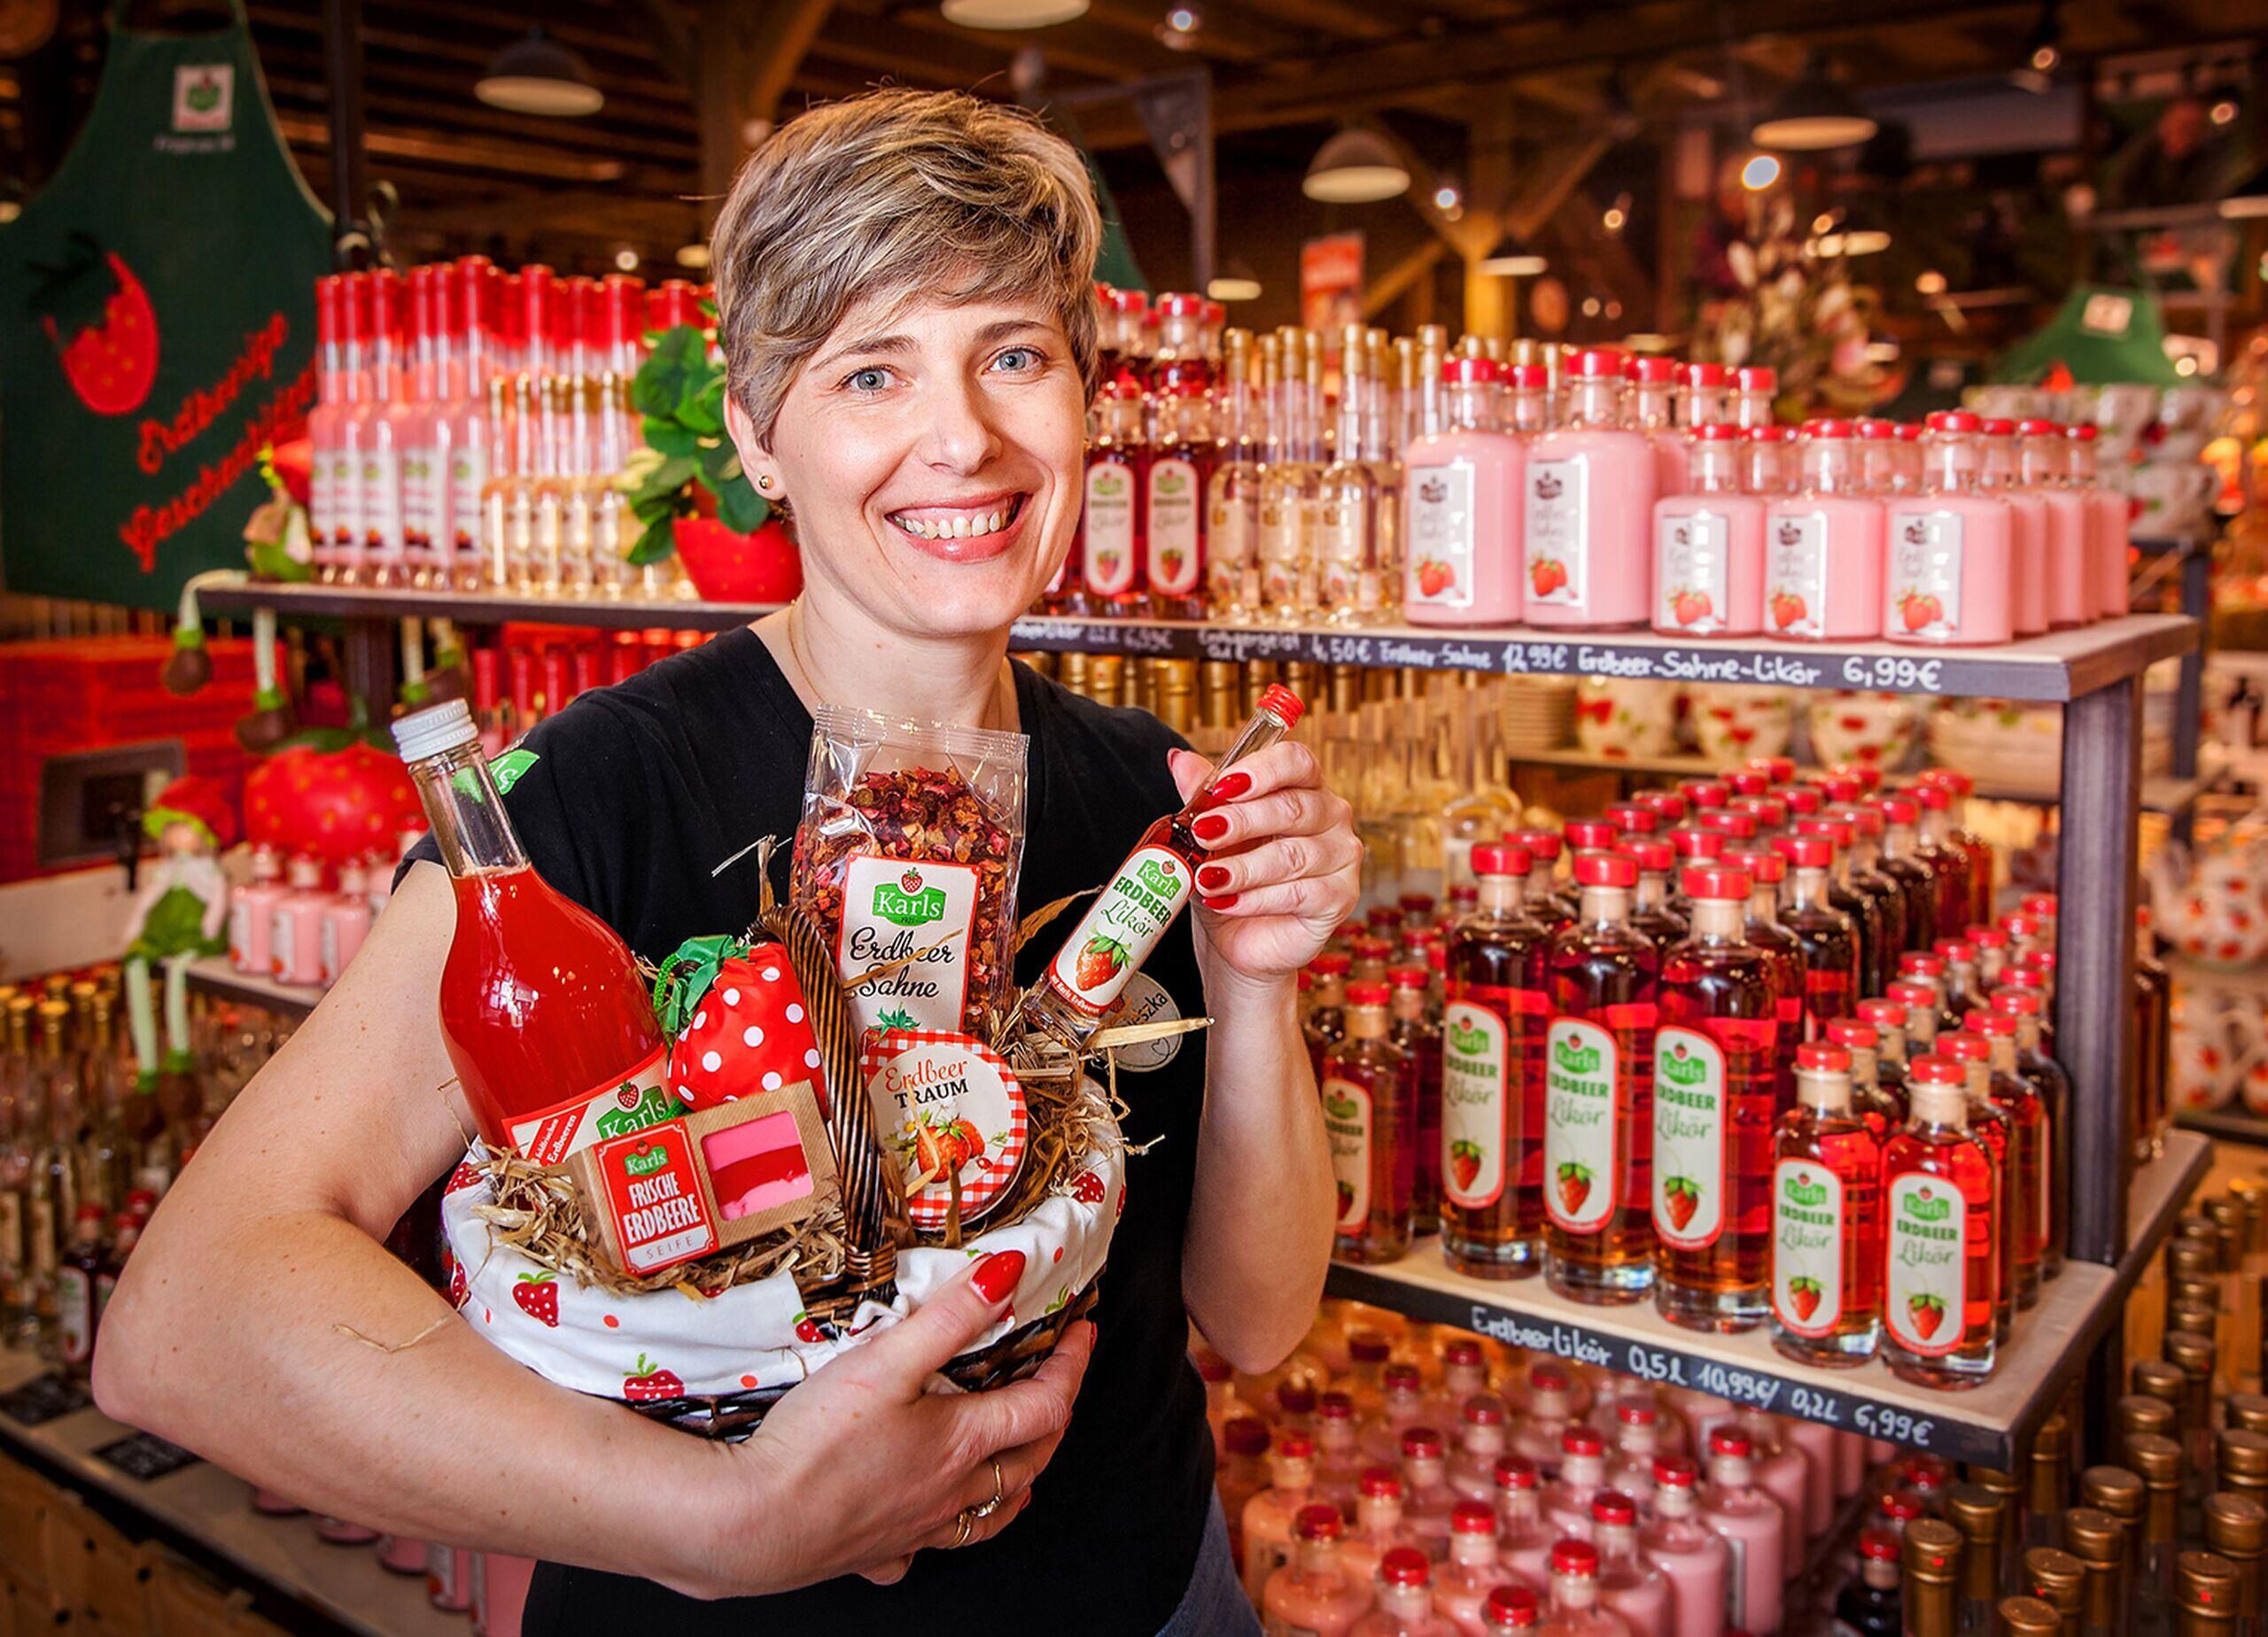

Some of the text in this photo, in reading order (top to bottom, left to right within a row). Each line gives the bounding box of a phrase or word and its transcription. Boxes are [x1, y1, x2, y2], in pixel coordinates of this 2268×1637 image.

[1843, 656, 1942, 691] 6,99€
[1139, 863, 1177, 901] Karls
[877, 891, 942, 917] Karls
[1100, 896, 1157, 938] Likör
[1113, 875, 1173, 928] ERDBEER
[884, 1058, 968, 1092] Erdbeer
[1555, 1044, 1601, 1073] Karls
[602, 1098, 667, 1139] Karls
[547, 1113, 578, 1163] Erdbeeren
[626, 1151, 667, 1174] Karls
[627, 1171, 681, 1209] FRISCHE
[622, 1193, 702, 1245] ERDBEERE
[1779, 1202, 1835, 1226] ERDBEER
[1896, 1218, 1958, 1241] ERDBEER
[646, 1235, 694, 1261] SEIFE
[1854, 1404, 1936, 1447] 6,99€
